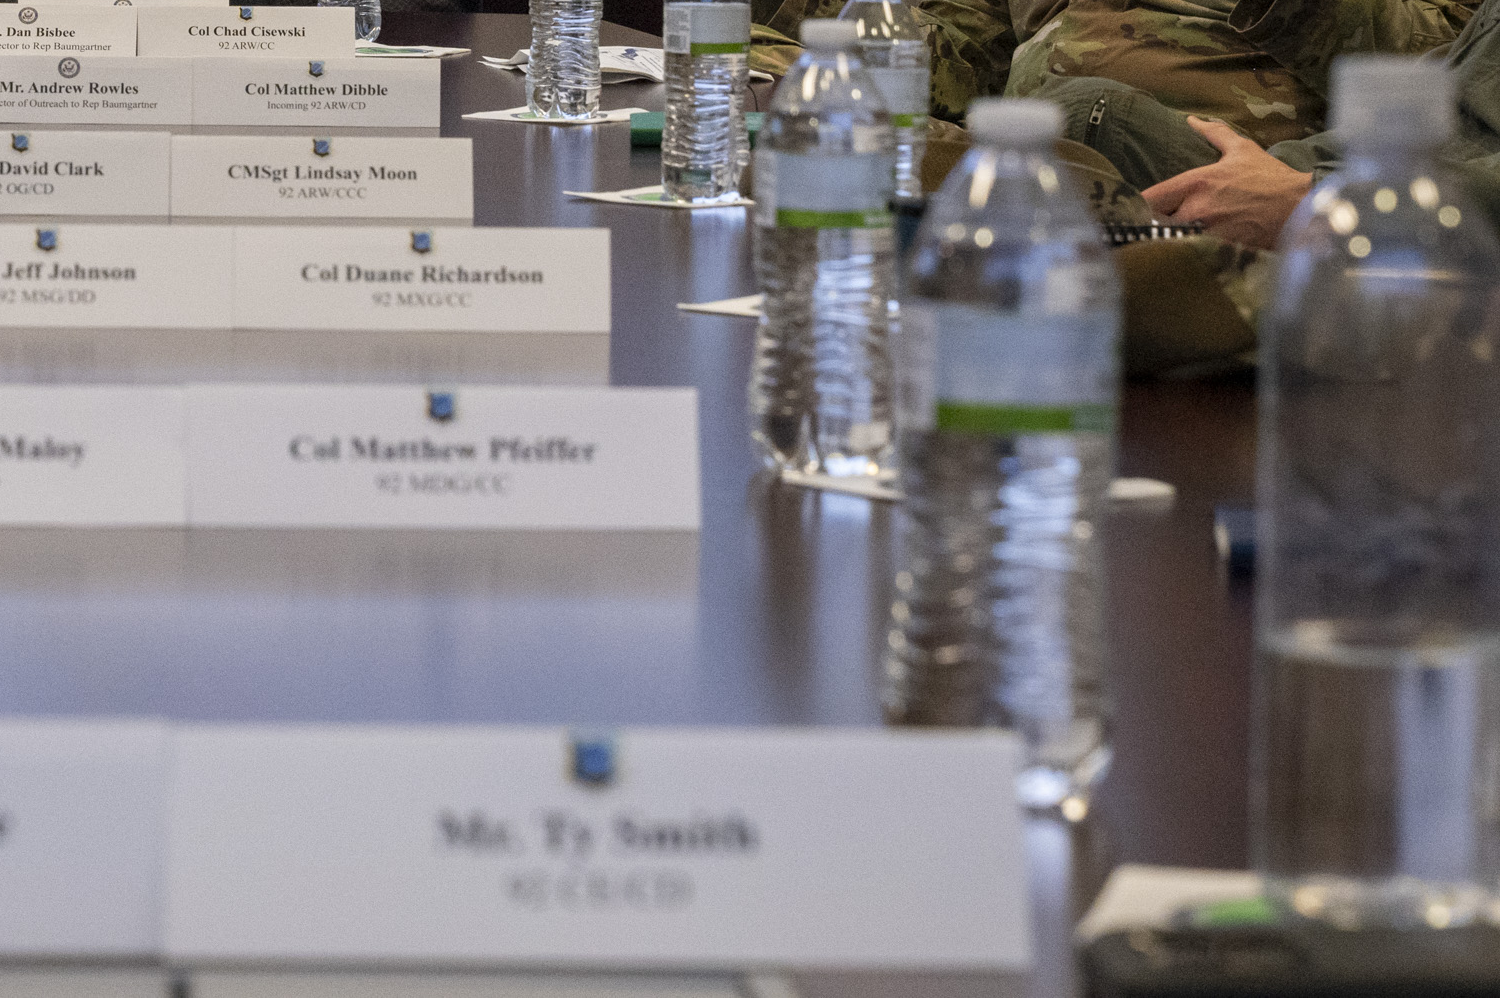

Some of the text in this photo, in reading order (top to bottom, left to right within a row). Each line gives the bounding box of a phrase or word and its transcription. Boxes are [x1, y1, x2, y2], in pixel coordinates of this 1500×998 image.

[6, 26, 32, 37] Dan
[36, 27, 76, 38] Bisbee
[187, 25, 306, 37] Col Chad Cisewski
[21, 42, 31, 50] to
[32, 41, 52, 52] Rep
[53, 41, 112, 53] Baumgartner
[218, 41, 275, 50] 92 ARW/CC
[0, 81, 139, 95] Mr. Andrew Rowles
[244, 83, 389, 96] Col Matthew Dibble
[17, 98, 29, 108] of
[28, 99, 69, 109] Outreach
[70, 100, 81, 109] to
[81, 99, 100, 111] Rep
[101, 99, 158, 111] Baumgartner
[267, 100, 367, 112] Incoming 92 ARW/CD
[53, 161, 104, 177] Clark
[227, 164, 418, 184] CMSgt Lindsay Moon
[5, 182, 55, 195] OG/CD
[278, 186, 367, 199] 92 ARW/CCC
[2, 262, 44, 280] Jeff
[48, 262, 137, 281] Johnson
[300, 264, 544, 284] Col Duane Richardson
